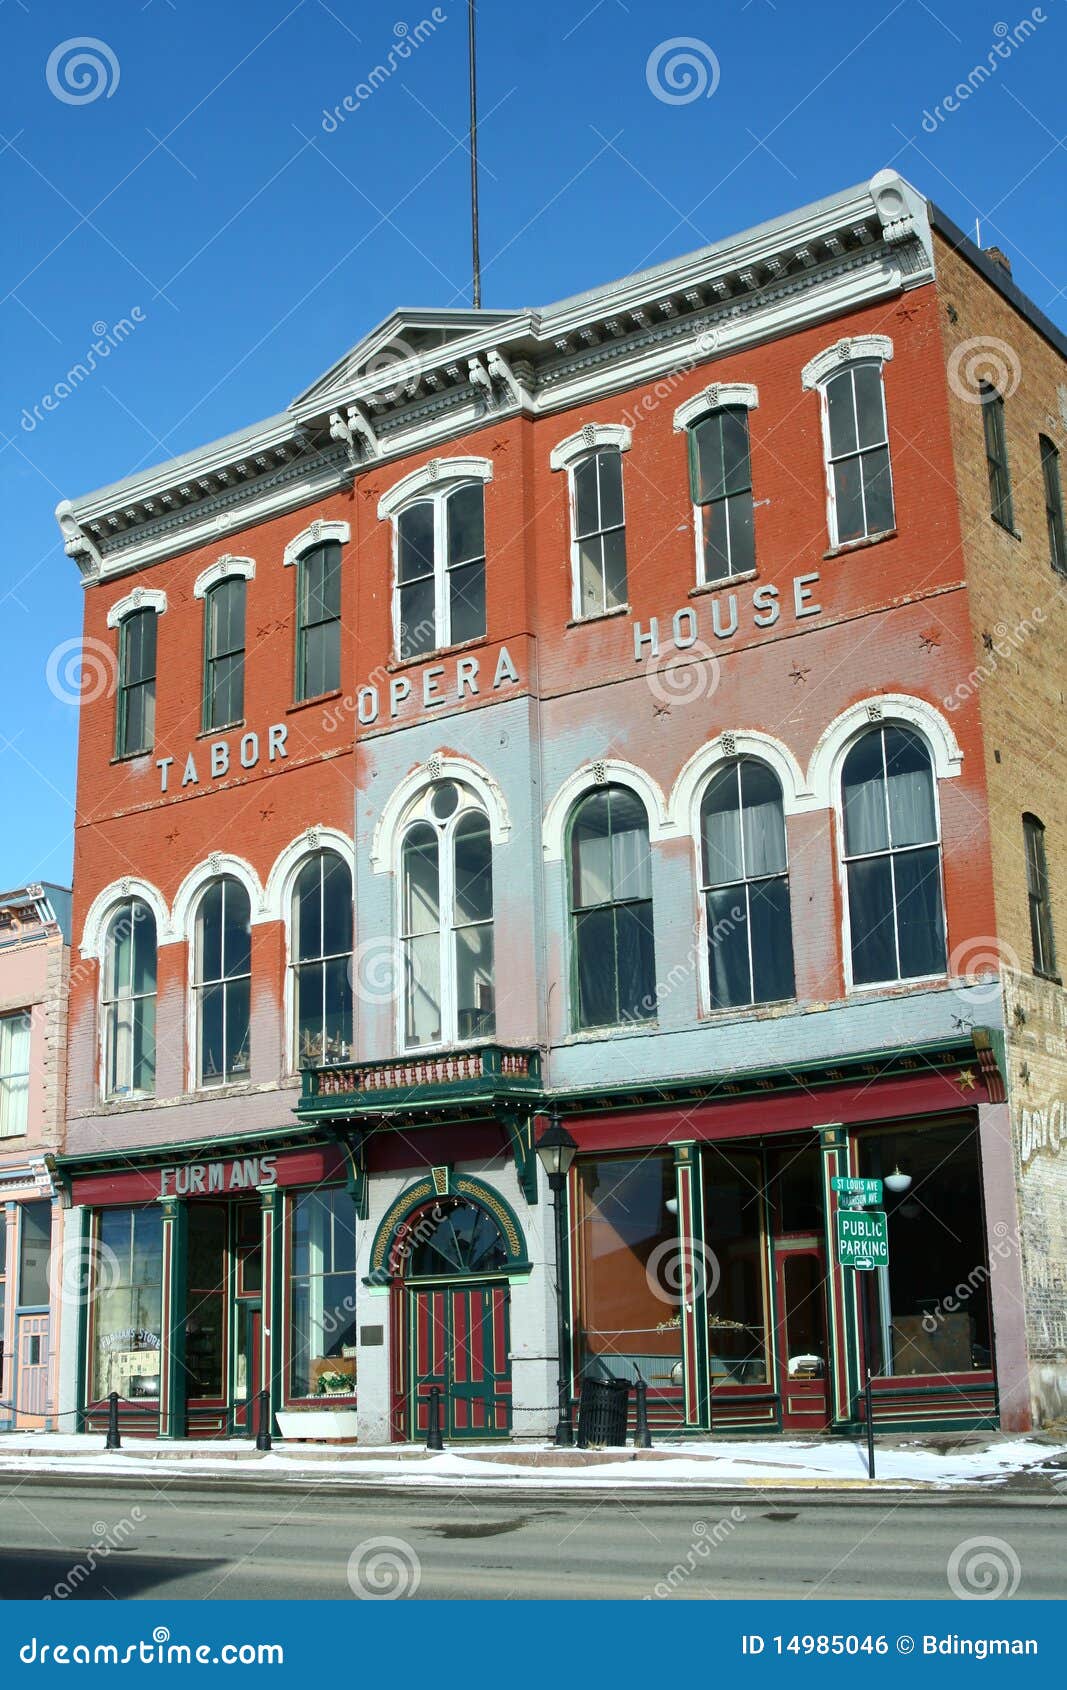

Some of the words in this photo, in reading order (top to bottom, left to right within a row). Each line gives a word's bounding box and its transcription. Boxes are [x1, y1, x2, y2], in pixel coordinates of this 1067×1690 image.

[156, 723, 289, 792] TABOR
[357, 646, 520, 726] OPERA
[633, 572, 823, 662] HOUSE
[161, 1156, 278, 1196] FURMANS
[837, 1179, 844, 1190] ST
[846, 1179, 865, 1191] LOUIS
[866, 1180, 878, 1191] AVE
[868, 1192, 878, 1203] AVE
[842, 1220, 883, 1237] PUBLIC
[840, 1239, 887, 1257] PARKING
